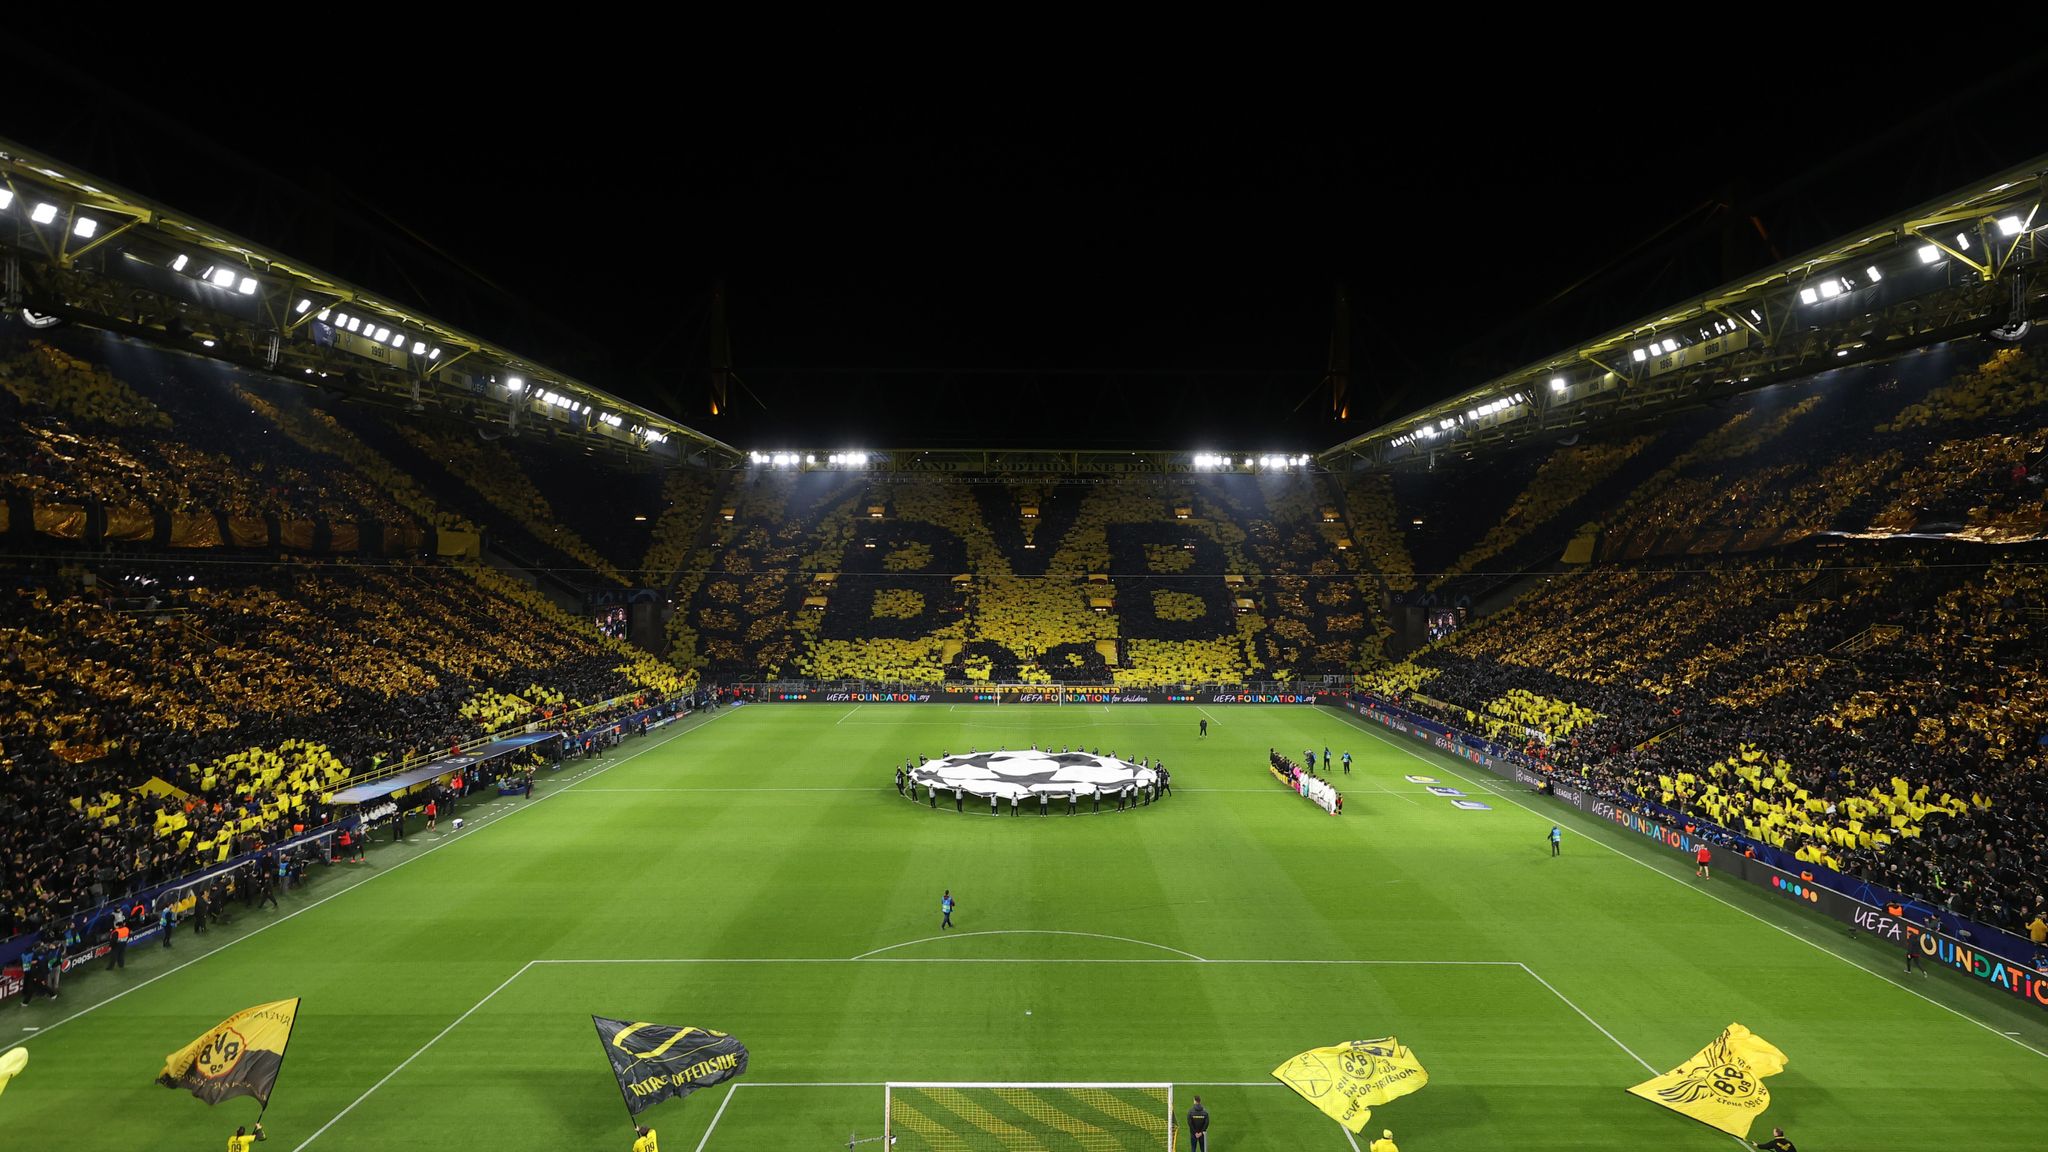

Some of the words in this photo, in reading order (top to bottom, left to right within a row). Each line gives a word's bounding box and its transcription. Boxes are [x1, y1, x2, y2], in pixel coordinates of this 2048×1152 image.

[826, 694, 850, 702] UEFA
[851, 693, 917, 702] FOUNDATION
[1020, 694, 1043, 702] UEFA
[1044, 693, 1110, 702] FONDATION
[1122, 694, 1148, 702] children
[1213, 694, 1236, 702] UEFA
[1237, 693, 1303, 702] FOUNDATION
[1556, 787, 1572, 800] LEAGUE
[1592, 800, 1614, 820] UEFA
[1616, 808, 1690, 852] FOUNDATION
[1854, 906, 1901, 941] UEFA
[71, 951, 94, 967] pepsi
[671, 1053, 737, 1087] OFFENSIVE
[1344, 1052, 1368, 1073] BVB
[1713, 1067, 1744, 1096] BVB
